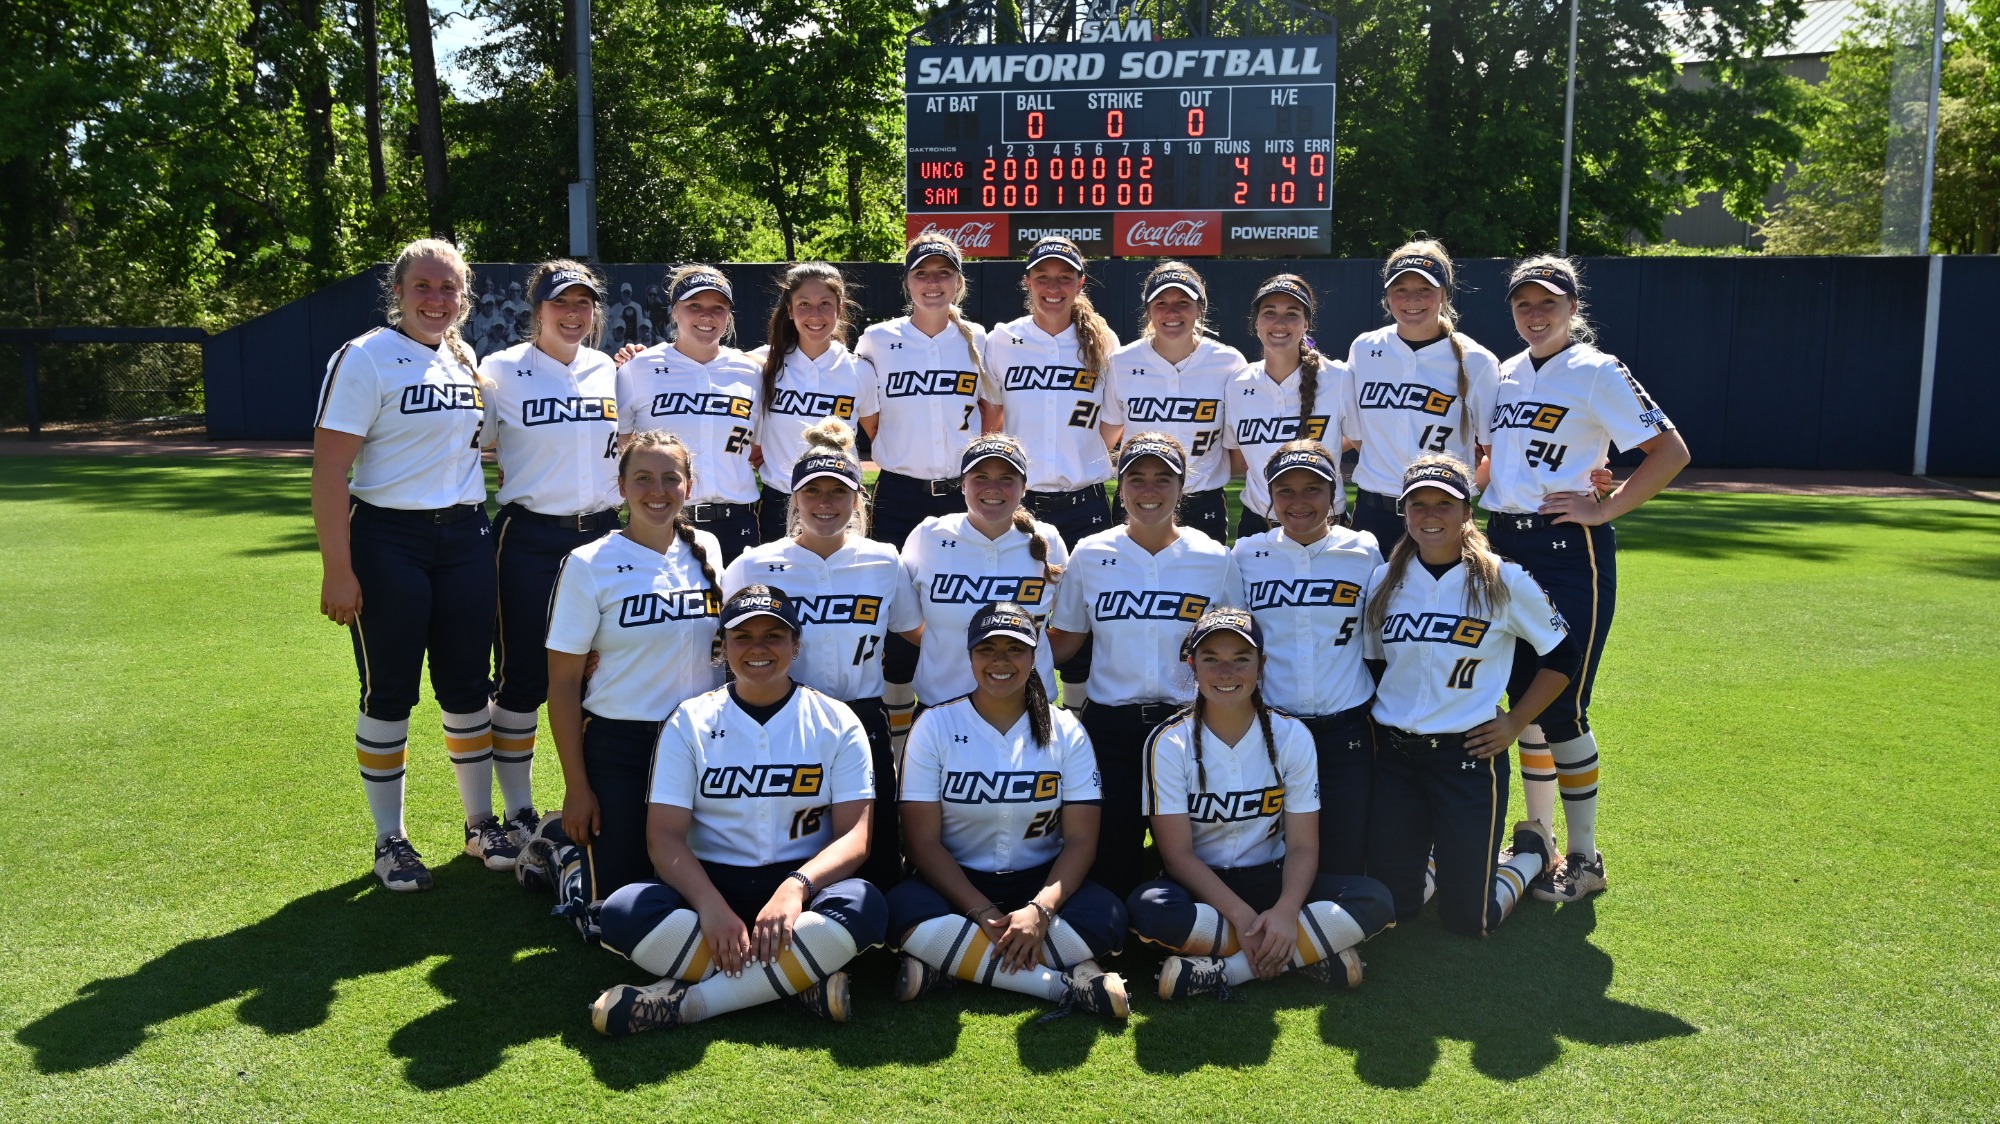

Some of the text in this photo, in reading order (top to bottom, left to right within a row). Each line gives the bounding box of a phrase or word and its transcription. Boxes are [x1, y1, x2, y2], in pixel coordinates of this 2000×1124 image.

[1080, 19, 1152, 43] SAM
[917, 47, 1323, 85] SAMFORD SOFTBALL
[926, 96, 979, 113] AT BAT
[1016, 94, 1056, 111] BALL
[1088, 91, 1143, 110] STRIKE
[1179, 90, 1213, 108] OUT
[1271, 88, 1298, 107] H/E
[1027, 111, 1044, 139] 0
[1107, 110, 1123, 138] 0
[1187, 108, 1204, 137] 0
[987, 139, 1330, 158] 1 2 3 4 5 6 7 8 9 10 RUNS HITS ERR
[921, 161, 964, 180] UNCG
[924, 187, 958, 205] SAM
[1126, 220, 1208, 247] Coca-Cola
[1231, 226, 1319, 240] POWERADE
[1037, 244, 1072, 254] UNCG
[1396, 258, 1433, 268] UNCG
[552, 270, 588, 284] UNCG
[690, 275, 724, 287] UNCG
[1155, 272, 1188, 284] UNCG
[886, 369, 978, 398] UNCG
[1005, 365, 1098, 393] UNCG
[651, 392, 753, 421] UNCG
[769, 388, 855, 420] UNCG
[1127, 397, 1222, 423] UNCG
[1359, 381, 1457, 417] UNCG
[975, 441, 1014, 455] UNCG
[1131, 442, 1170, 454] UNCG
[1418, 424, 1453, 451] 13
[805, 457, 846, 472] UNCG
[1279, 452, 1319, 466] UNCG
[1525, 439, 1567, 472] 24
[1413, 466, 1452, 479] UNCG
[930, 573, 1046, 605] UNCG
[1250, 578, 1361, 611] UNCG
[740, 596, 782, 611] UNCG
[788, 594, 883, 626] NCG
[1095, 590, 1211, 622] UNCG
[980, 614, 1022, 629] UNCG
[1206, 615, 1246, 629] UNCG
[1334, 616, 1359, 647] 5
[1381, 612, 1491, 648] UNCG
[1446, 656, 1483, 690] 10
[700, 762, 824, 799] UNCG
[942, 770, 1062, 805] UNCG
[1188, 785, 1285, 823] UNCG
